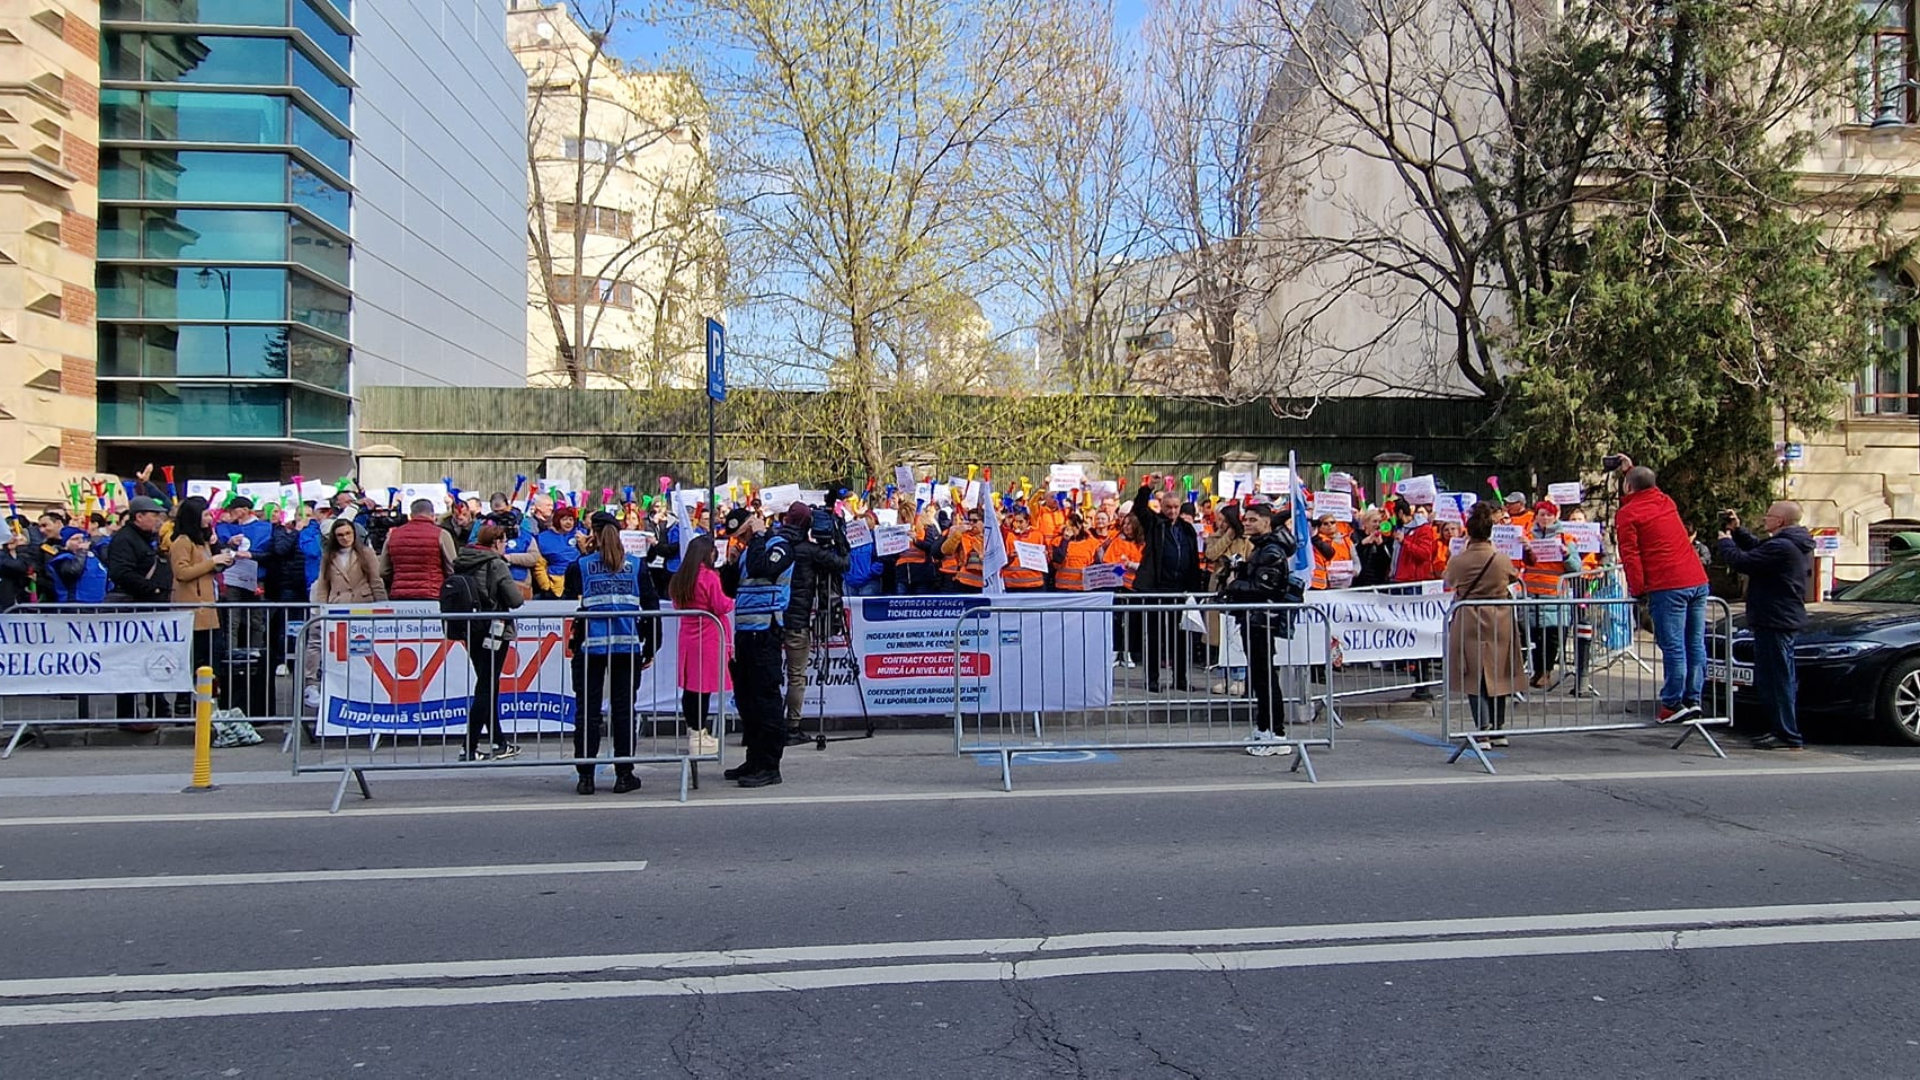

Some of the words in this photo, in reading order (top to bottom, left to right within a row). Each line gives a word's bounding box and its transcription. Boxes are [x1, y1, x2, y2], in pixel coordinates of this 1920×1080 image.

[713, 330, 721, 372] P
[590, 561, 632, 573] DIAG
[887, 609, 932, 618] TICHETELOR
[932, 609, 944, 617] DE
[67, 619, 185, 645] NATIONAL
[1343, 627, 1417, 651] SELGROS
[882, 656, 923, 664] CONTRACT
[923, 655, 955, 664] COLECTI
[877, 665, 905, 674] MUNCĂ
[916, 666, 938, 674] NIVEL
[338, 703, 409, 723] Împreună
[412, 706, 466, 722] suntem
